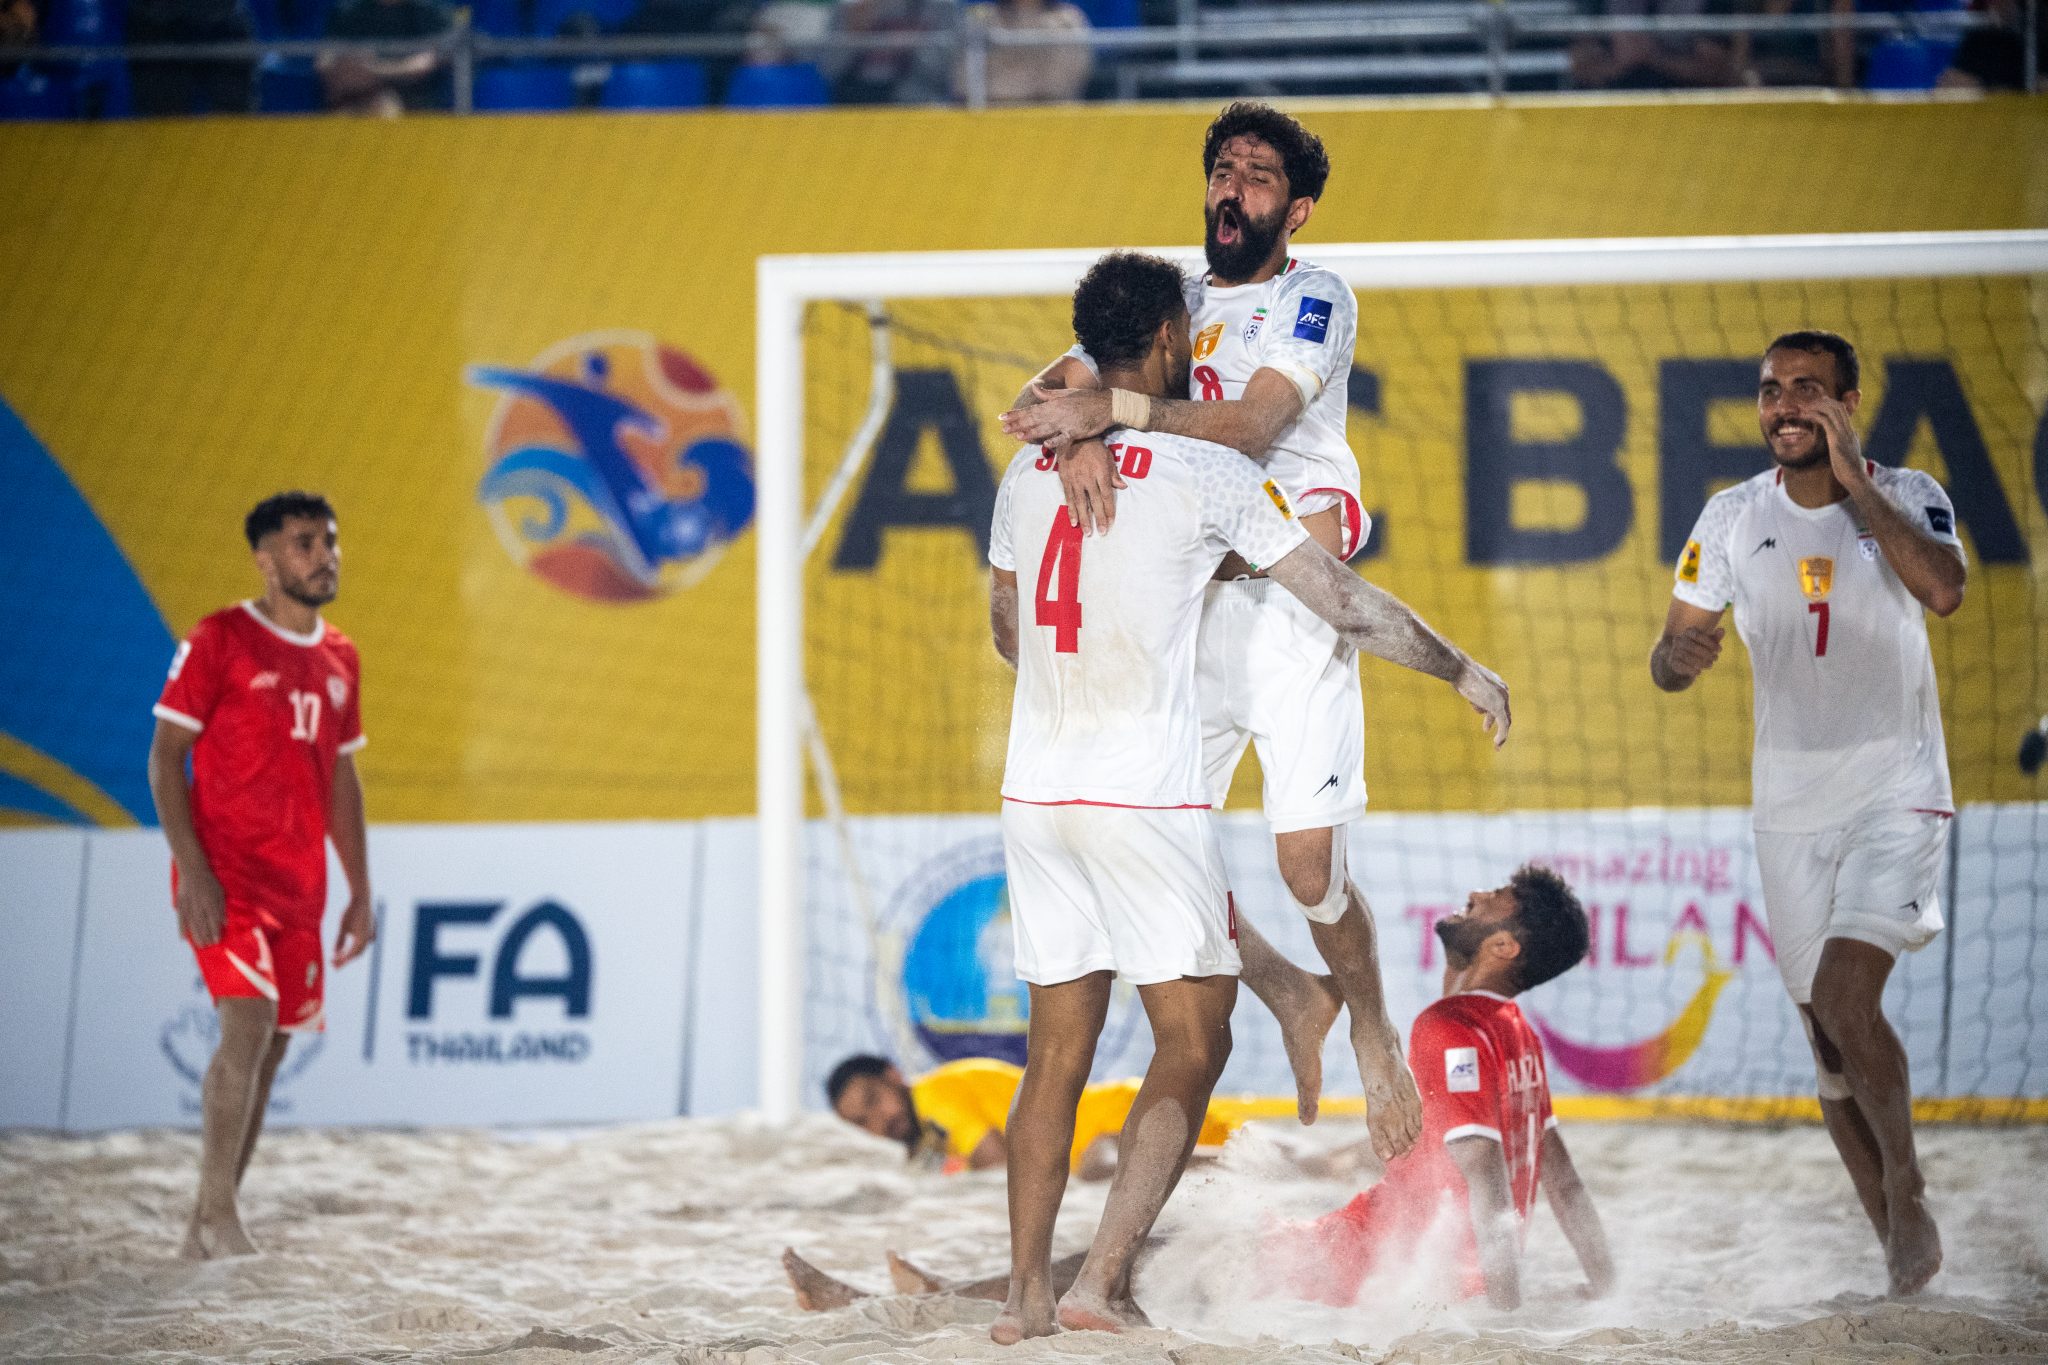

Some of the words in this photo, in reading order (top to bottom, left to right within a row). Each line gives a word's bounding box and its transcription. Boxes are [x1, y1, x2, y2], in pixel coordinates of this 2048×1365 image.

[1300, 312, 1327, 327] AFC
[1464, 357, 2048, 567] BEA
[1035, 505, 1083, 653] 4
[1808, 602, 1831, 657] 7
[289, 689, 322, 743] 10
[1528, 838, 1733, 893] mazing
[407, 899, 592, 1020] FA
[406, 1033, 589, 1063] THAILAND
